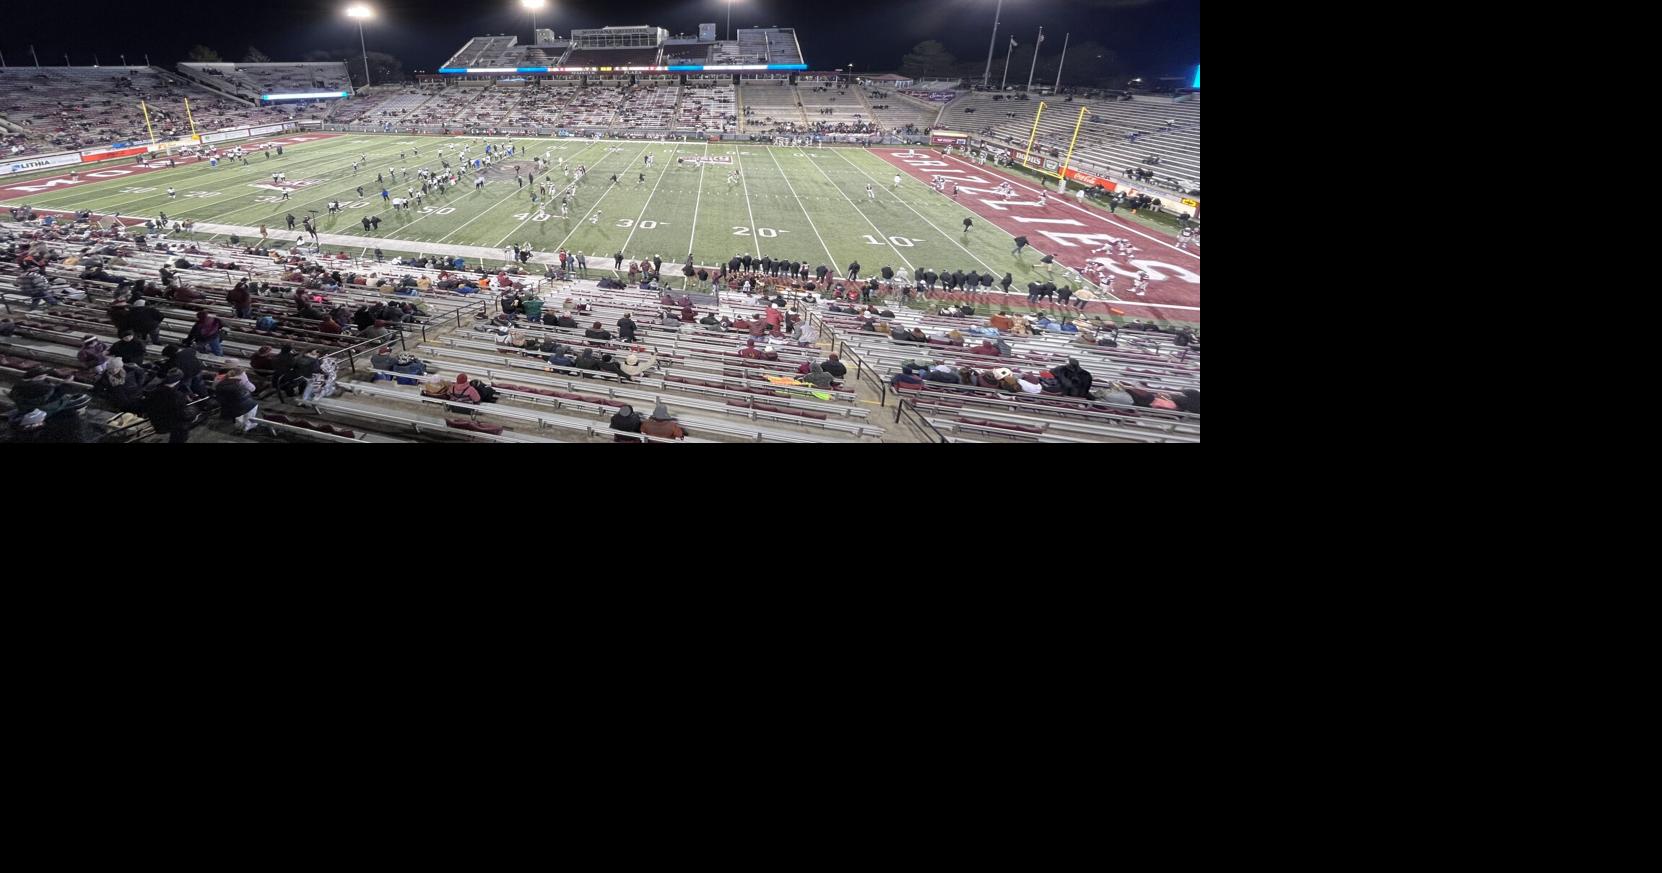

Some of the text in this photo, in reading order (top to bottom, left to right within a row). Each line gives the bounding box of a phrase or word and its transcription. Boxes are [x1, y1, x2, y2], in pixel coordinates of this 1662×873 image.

[20, 160, 51, 169] LITHIA
[417, 206, 456, 215] 50
[513, 212, 551, 221] 40
[616, 219, 657, 230] 30
[732, 226, 778, 238] 20
[862, 234, 914, 248] 10
